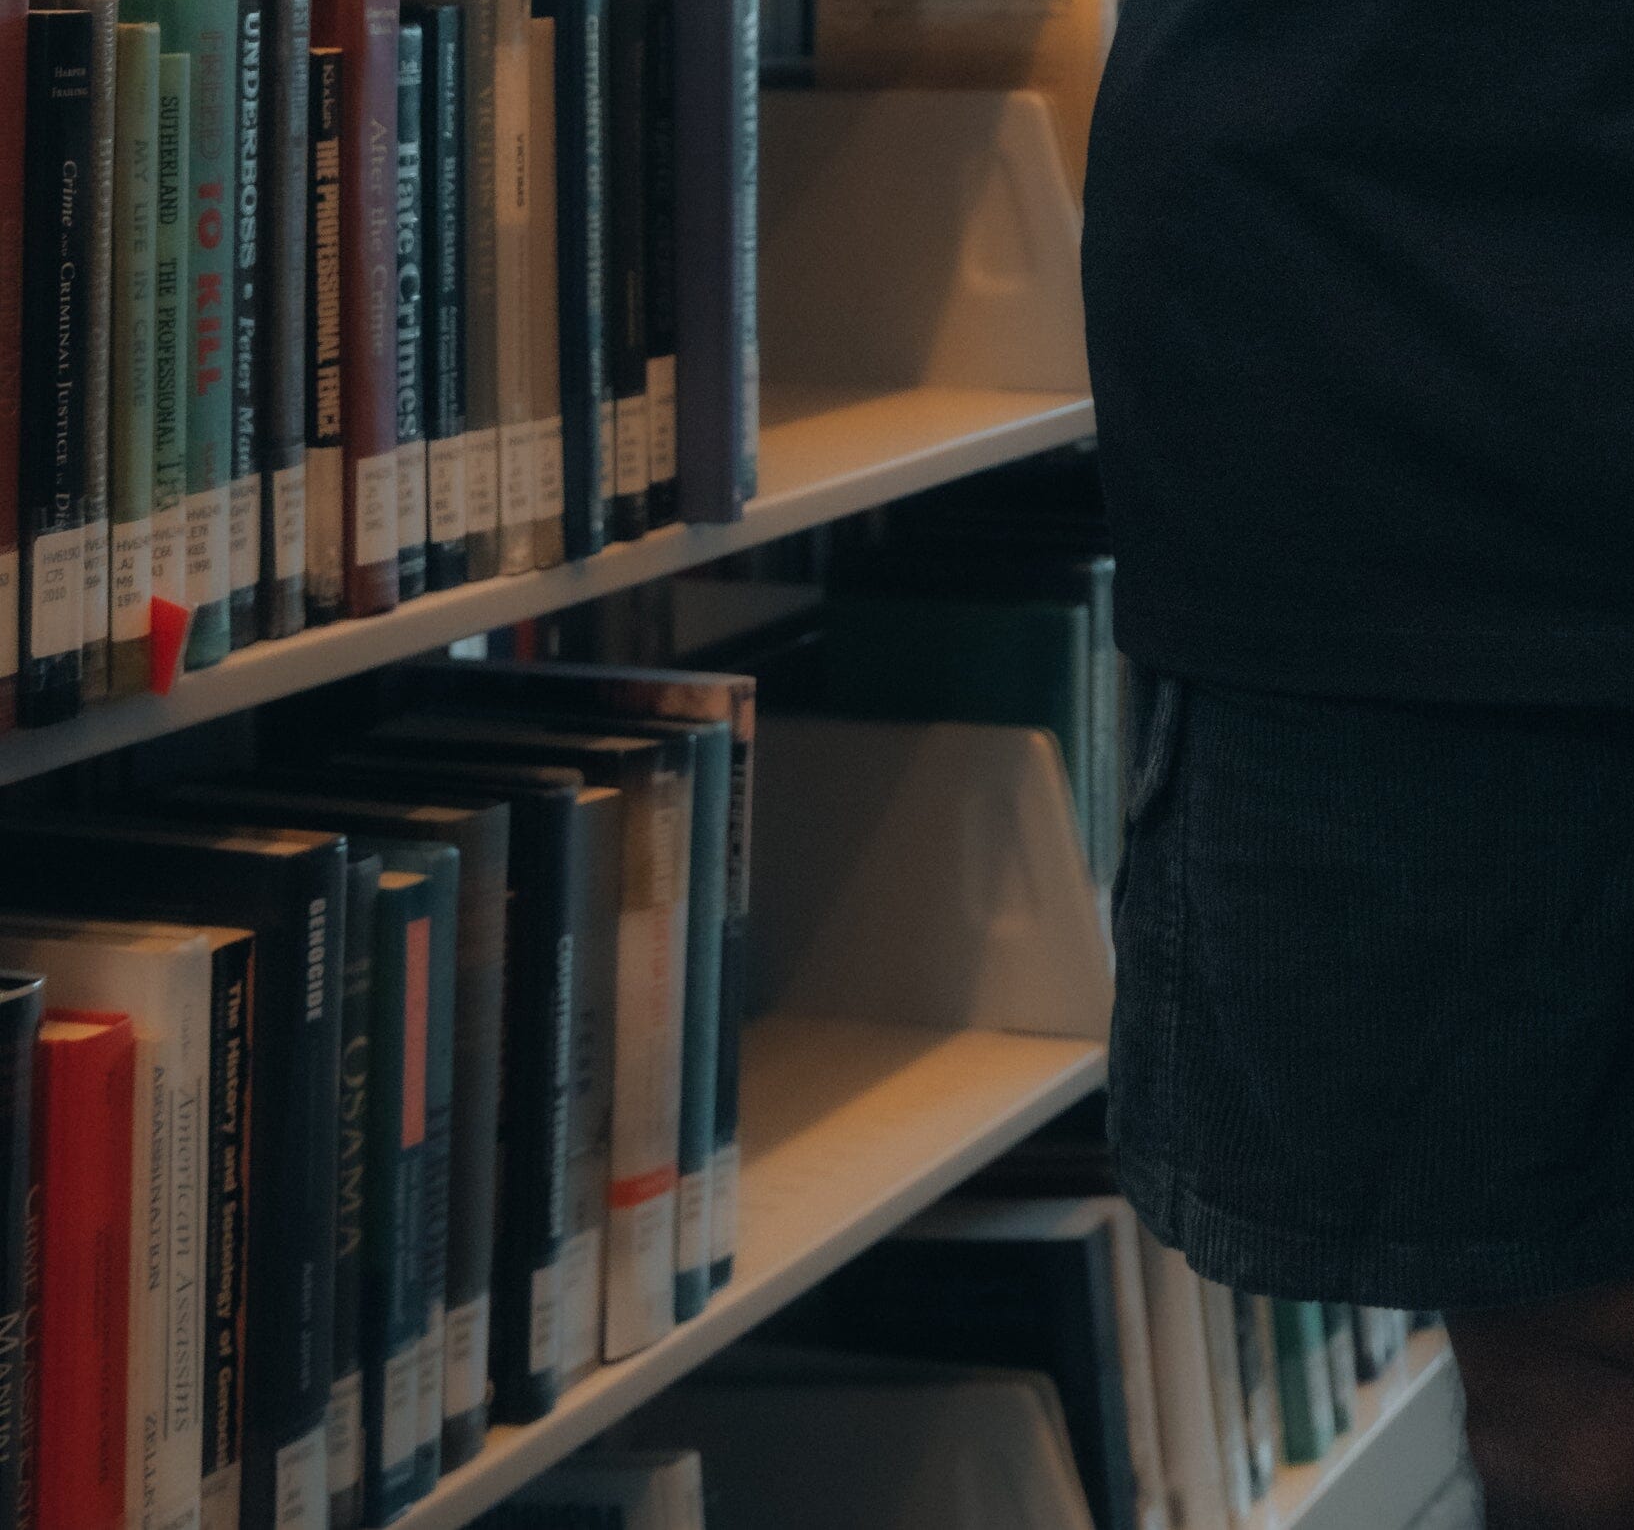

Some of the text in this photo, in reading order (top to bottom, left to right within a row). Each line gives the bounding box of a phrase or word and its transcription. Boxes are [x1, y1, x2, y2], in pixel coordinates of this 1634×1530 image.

[60, 160, 79, 227] Crime
[159, 96, 179, 226] SUTHERLAND
[240, 11, 261, 270] UNDERBOSS
[317, 138, 340, 181] THE
[134, 204, 148, 253] LIFE
[197, 181, 224, 250] TO
[369, 118, 389, 359] After the Crime
[57, 260, 77, 371] CRIMINAL
[158, 258, 177, 296] THE
[316, 183, 340, 366] PROFESSIONAL
[397, 140, 421, 437] Hate Crimes
[133, 320, 147, 408] CRIME
[156, 307, 178, 454] PROFESSIONAL
[196, 272, 223, 398] KILL
[55, 381, 74, 465] JUSTICE
[226, 981, 242, 1027] The
[306, 897, 327, 1022] GENOCIDE
[222, 1037, 240, 1135] History
[221, 1142, 239, 1192] and
[341, 1035, 368, 1259] OSAMA
[173, 1091, 195, 1432] American Assassins
[216, 1199, 238, 1318] Sociology
[215, 1363, 232, 1466] Genocid
